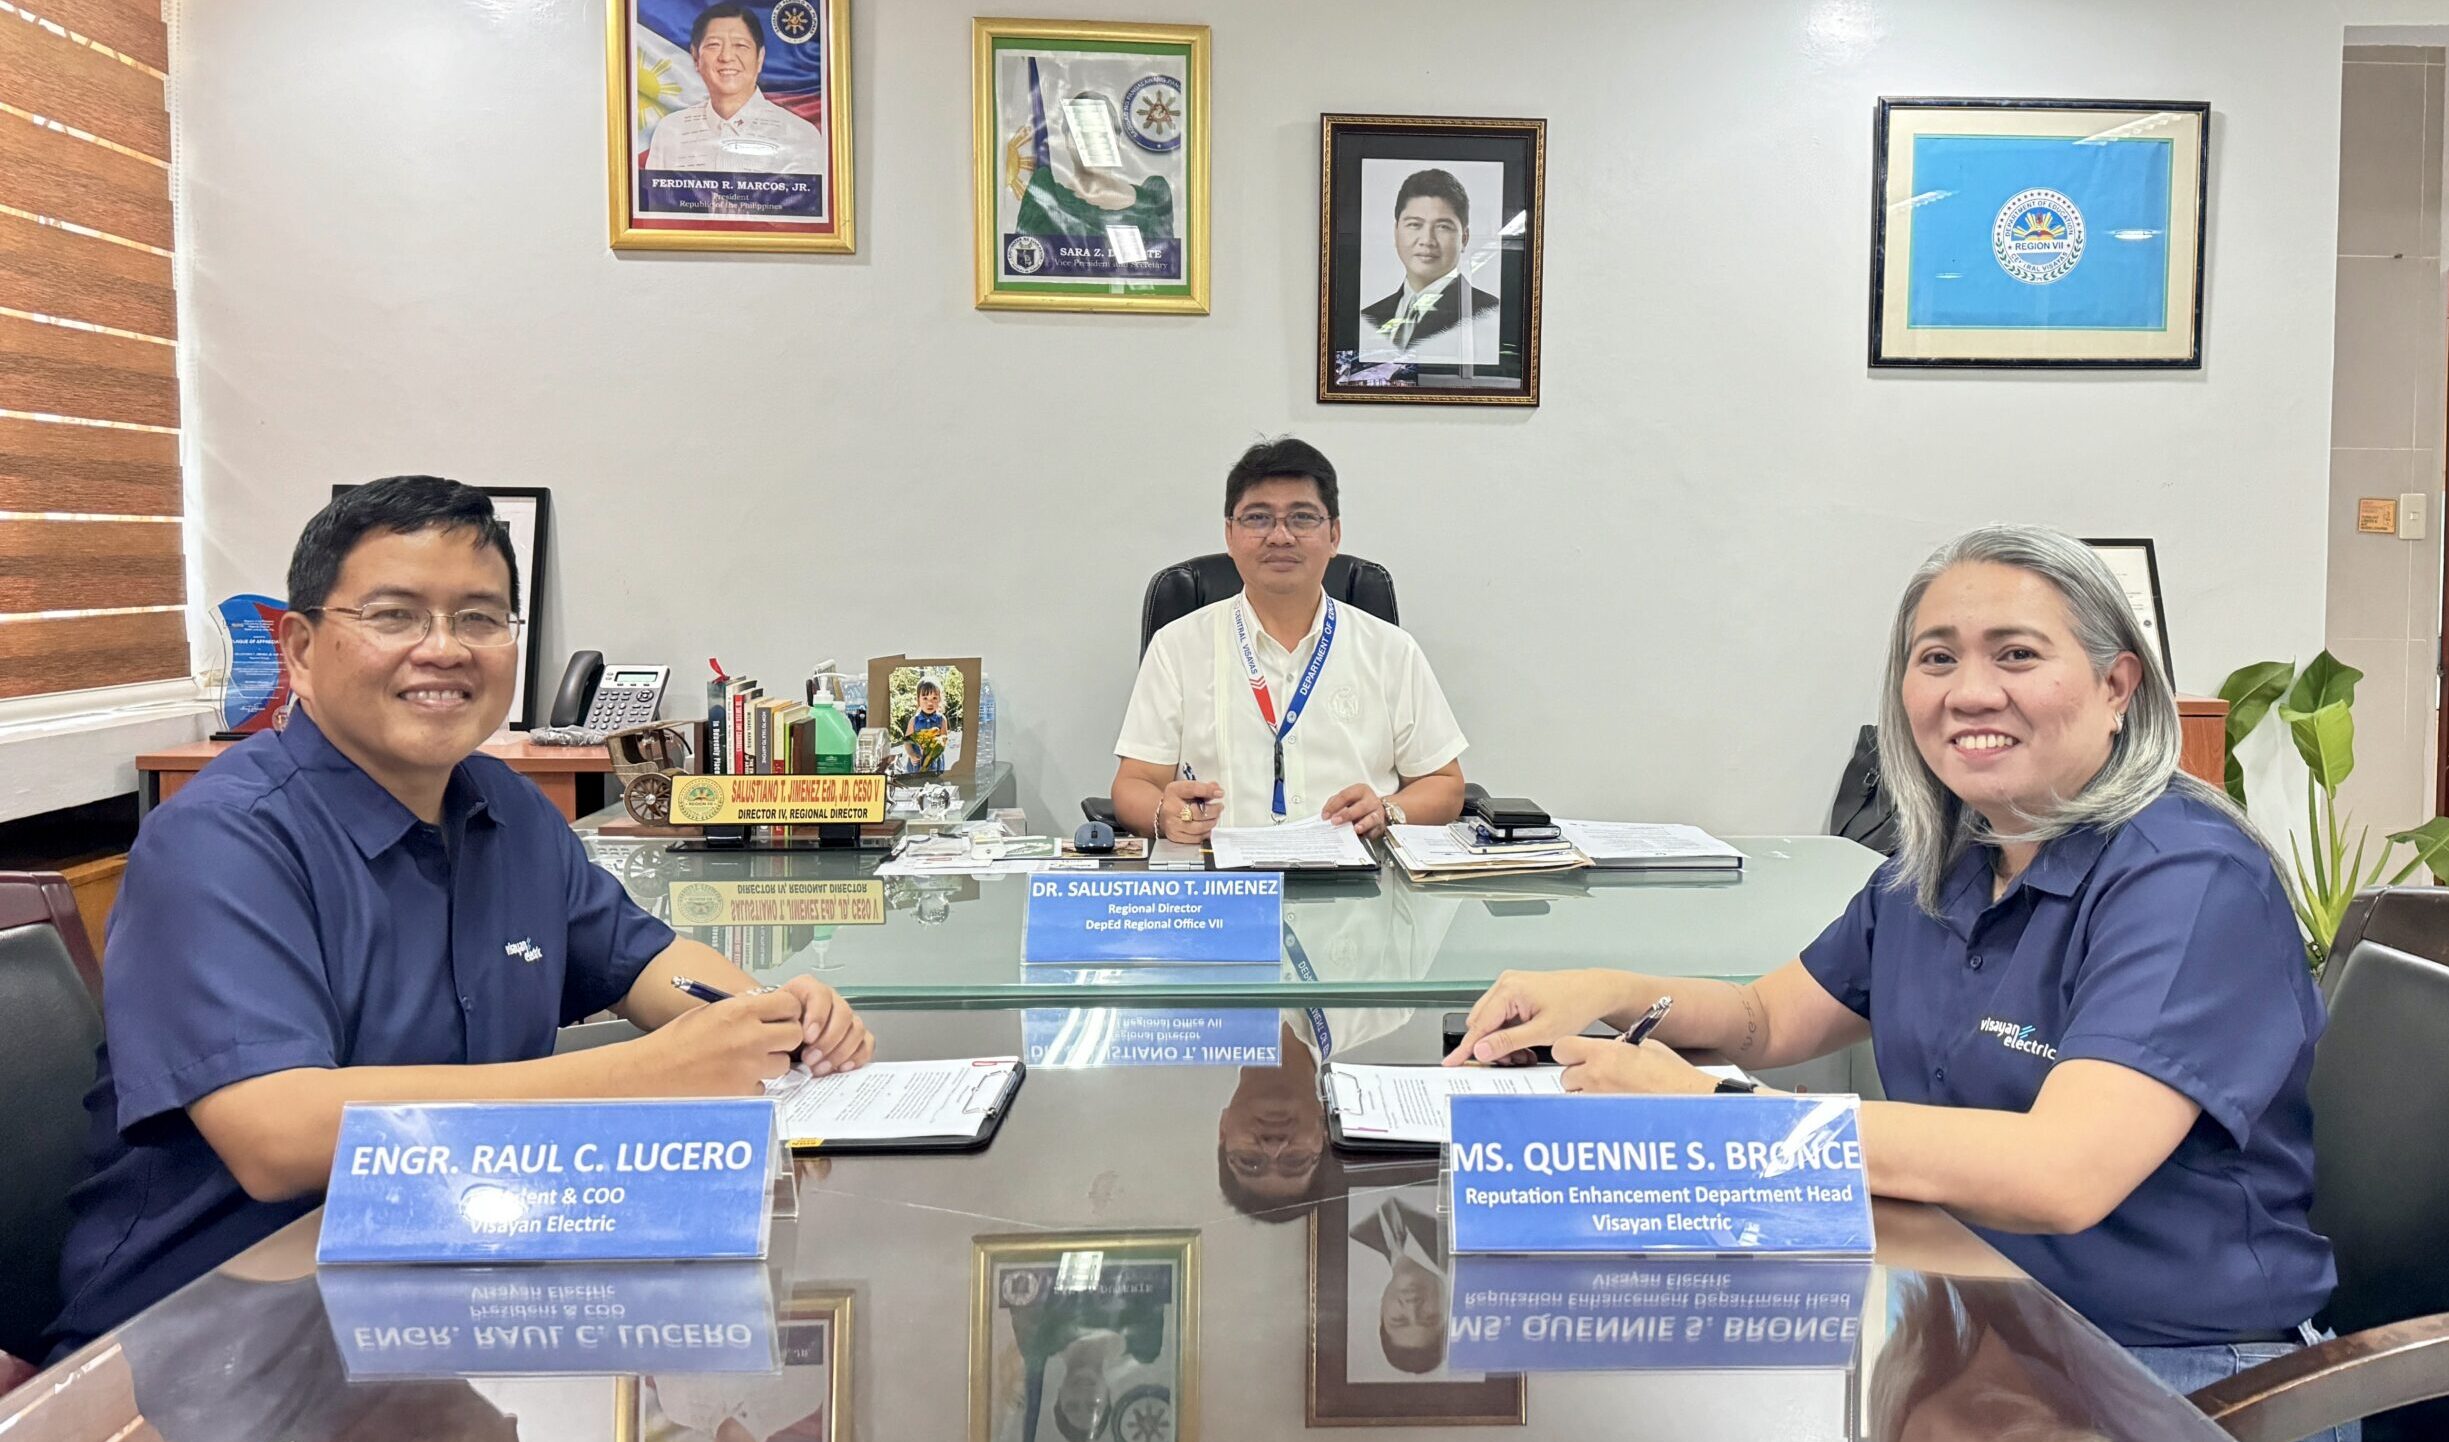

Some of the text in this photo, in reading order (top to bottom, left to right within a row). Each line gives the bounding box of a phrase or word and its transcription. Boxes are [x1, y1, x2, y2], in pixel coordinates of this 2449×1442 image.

[652, 178, 811, 192] FERDINAND R. MARCOS, JR.
[679, 200, 713, 209] Republic
[739, 202, 783, 211] Philippines
[713, 192, 750, 201] President
[2005, 202, 2036, 237] DEPARTMENT
[2048, 202, 2073, 235] EDUCATION
[1060, 247, 1091, 257] SARA
[1094, 248, 1104, 257] Z.
[2015, 242, 2050, 250] REGION
[1054, 259, 1072, 267] Vice
[1073, 259, 1110, 268] President
[2042, 252, 2068, 271] VISAYAS
[1235, 609, 1258, 675] CENTRAL VISAYAS
[1300, 637, 1329, 696] DEPARTMENT
[1324, 622, 1333, 636] OF
[732, 780, 778, 803] SALUSTIANO
[780, 780, 786, 802] T.
[788, 780, 821, 803] JIMENEZ
[821, 780, 838, 806] EdD,
[839, 780, 850, 806] JD,
[852, 780, 872, 802] CESO
[873, 779, 880, 802] V
[738, 808, 868, 821] DIRECTOR IV, REGIONAL DIRECTOR
[1032, 880, 1279, 898] DR. SALUSTIANO T. JIMENEZ
[1108, 902, 1202, 916] Regional Director
[1085, 917, 1223, 931] DepEd Regional Office VII
[505, 941, 528, 956] visayan
[524, 946, 543, 962] electric
[1980, 1016, 2020, 1037] visayan
[2004, 1035, 2057, 1060] electric
[351, 1140, 753, 1175] ENGR. RAUL C. LUCERO
[1453, 1141, 1861, 1176] MS. QUENNIE S. BRONCE
[561, 1187, 577, 1205] &
[583, 1187, 626, 1205] COO
[1465, 1184, 1853, 1206] Reputation Enhancement Department Head
[470, 1214, 616, 1237] Visayan Electric
[1592, 1213, 1733, 1235] Visayan Electric
